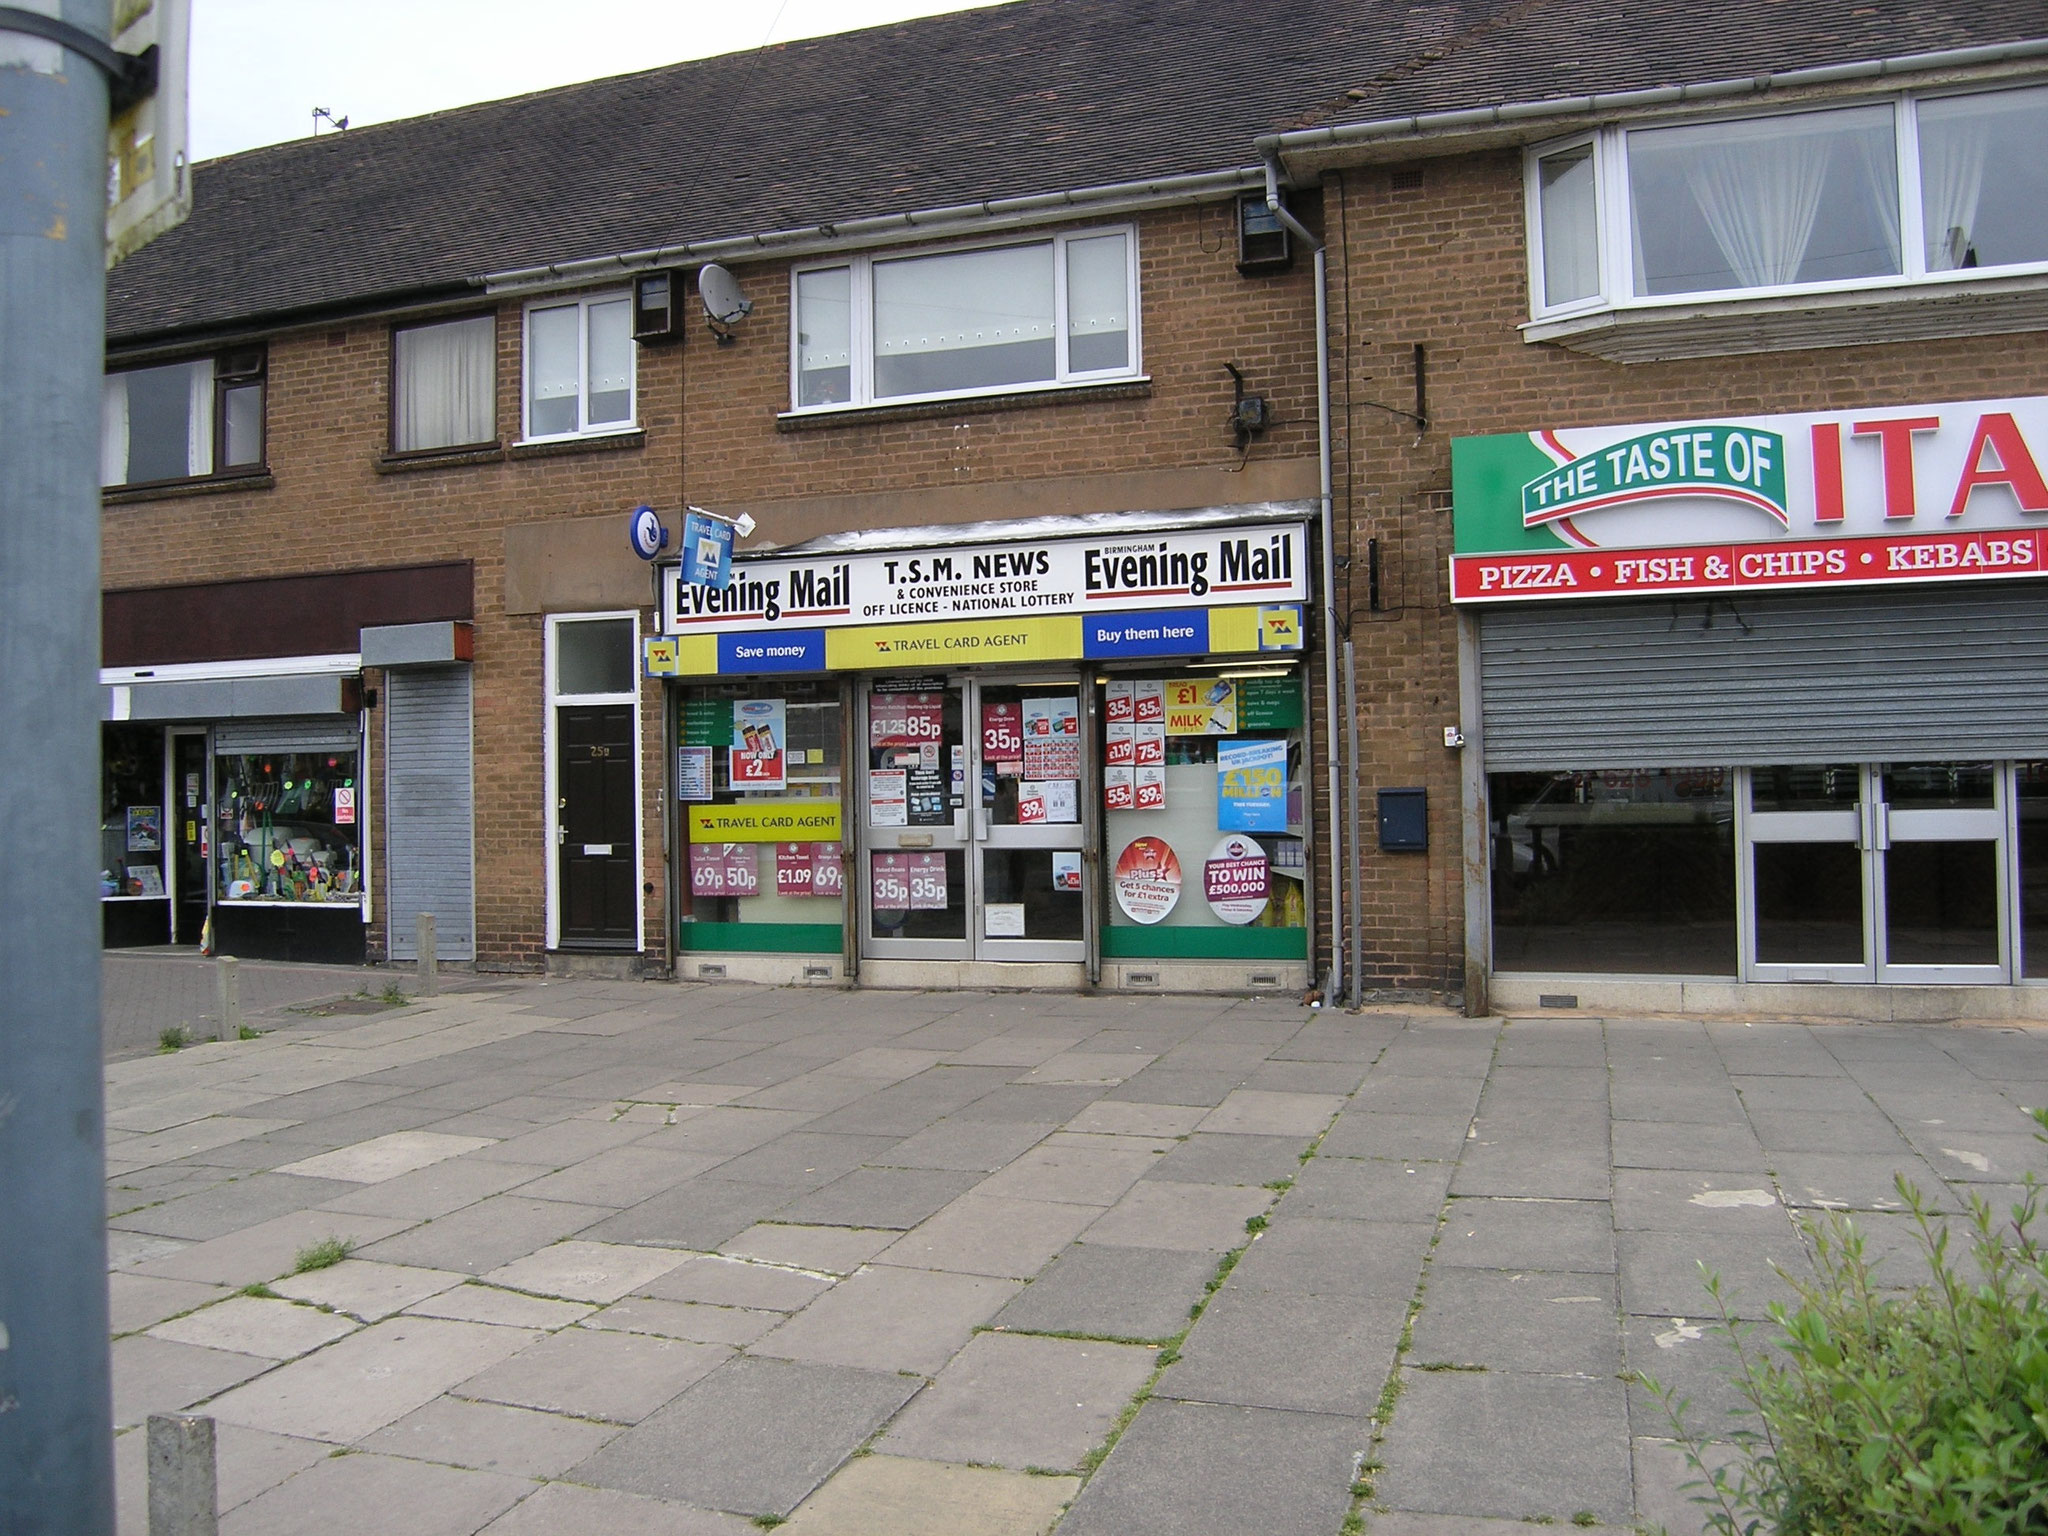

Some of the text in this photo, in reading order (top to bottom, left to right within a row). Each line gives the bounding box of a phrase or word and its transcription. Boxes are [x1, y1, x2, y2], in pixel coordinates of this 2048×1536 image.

[1532, 432, 1771, 505] THE TASTE OF
[1811, 412, 2048, 523] ITA
[691, 521, 731, 541] TRAVEL CARD
[1104, 544, 1155, 554] BIRMINGHAM
[884, 550, 1050, 584] T.S.M. NEWS
[1085, 533, 1292, 596] Evening Mail
[1479, 540, 2033, 590] PIZZA FISH & CHIPS KEBABS
[695, 568, 718, 580] AGENT
[676, 564, 850, 621] Evening Mail
[897, 580, 1038, 599] & CONVENIENCE STORE
[863, 602, 885, 617] OFF
[890, 601, 939, 615] LICENCE
[952, 597, 1016, 612] NATIONAL
[1021, 593, 1075, 608] LOTTERY
[894, 634, 1028, 651] TRAVEL CARD AGENT
[1097, 626, 1194, 643] Buy them here
[736, 646, 806, 658] Save money
[1177, 685, 1197, 704] £1
[1108, 700, 1131, 716] 35p
[1139, 701, 1160, 716] 35p
[871, 720, 906, 734] £1.25
[907, 716, 941, 739] 85p
[1170, 714, 1203, 727] MILK
[985, 729, 1020, 752] 35p
[740, 751, 775, 760] NOW ONLY
[1138, 744, 1161, 760] 75p
[745, 759, 763, 776] £2
[1223, 768, 1283, 786] £150
[1108, 787, 1130, 804] 55p
[1139, 787, 1161, 804] 39p
[1022, 801, 1045, 817] 39p
[716, 816, 836, 828] TRAVEL CARD AGENT
[1209, 861, 1225, 869] YOUR
[695, 867, 723, 889] 69p
[727, 867, 756, 889] 50p
[777, 869, 811, 884] £1.09
[815, 867, 842, 889] 69p
[1209, 867, 1265, 883] TO WIN
[875, 878, 908, 901] 35p
[911, 878, 946, 900] 35p
[1120, 881, 1134, 889] Get
[1142, 884, 1175, 894] chances
[1124, 890, 1136, 898] for
[1148, 893, 1169, 901] extra
[1209, 882, 1265, 896] £500,000
